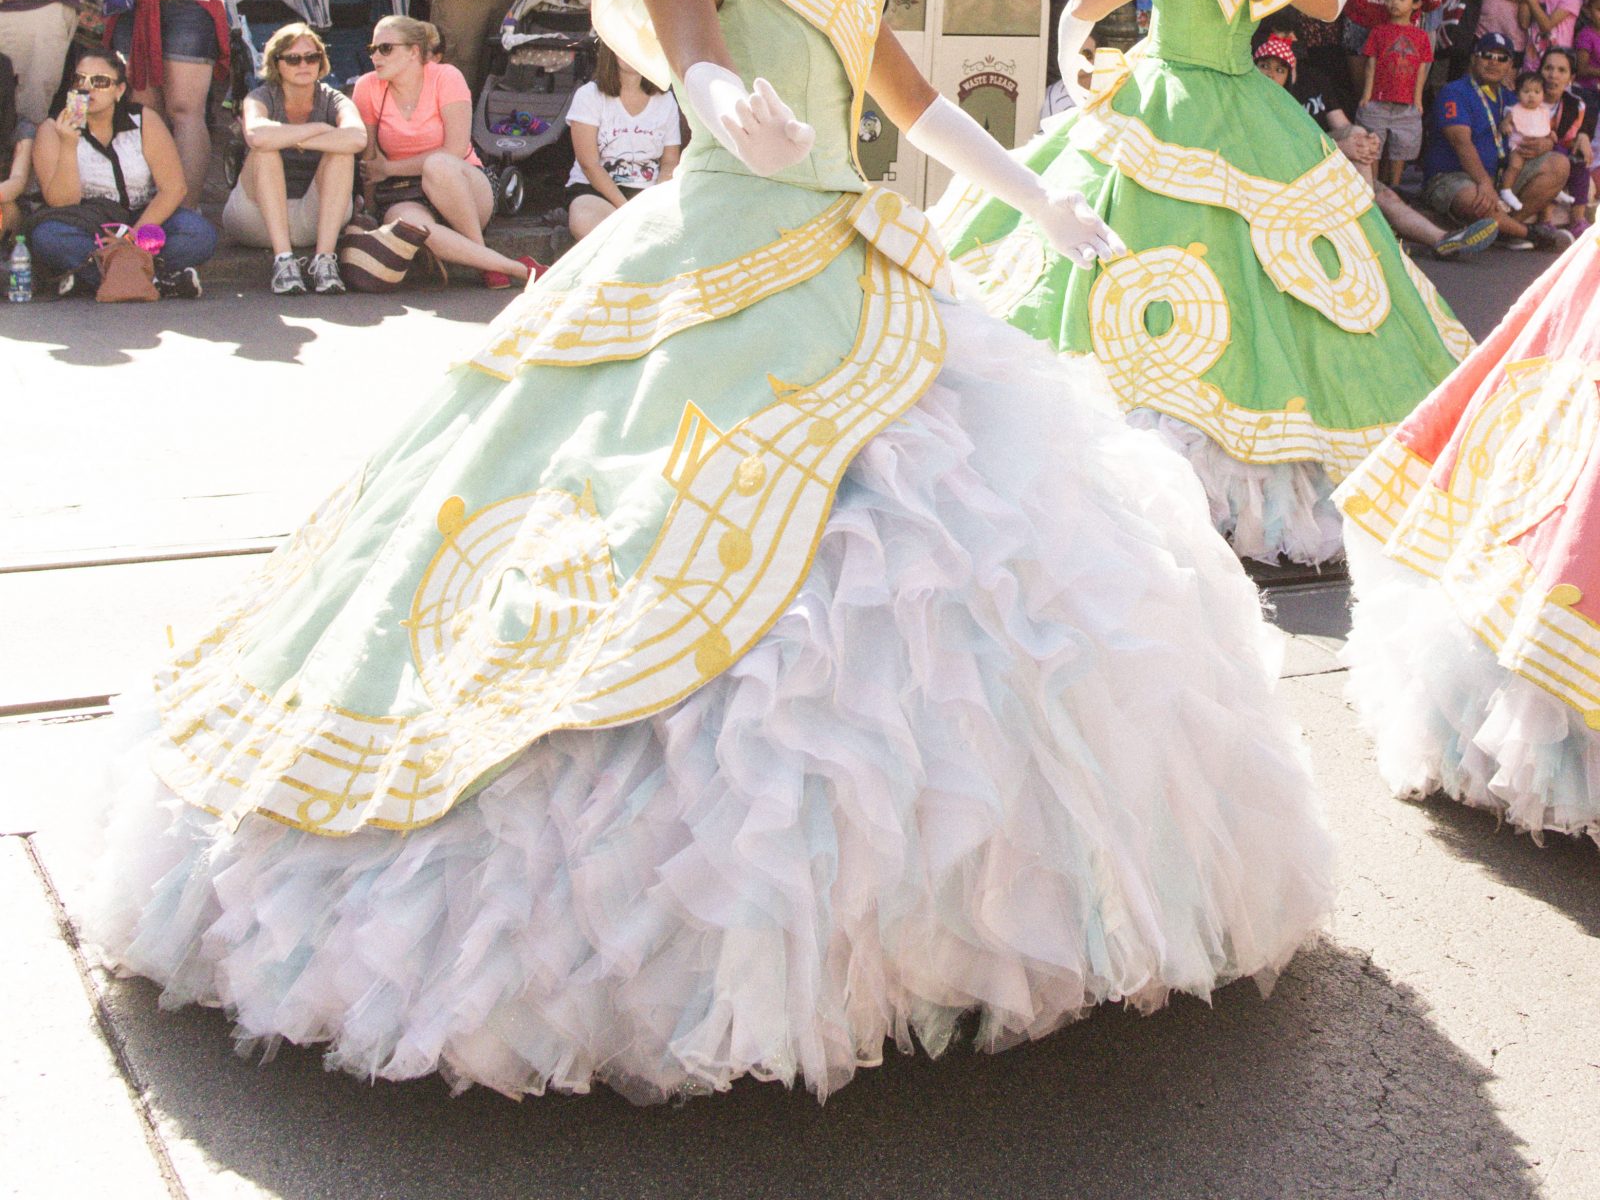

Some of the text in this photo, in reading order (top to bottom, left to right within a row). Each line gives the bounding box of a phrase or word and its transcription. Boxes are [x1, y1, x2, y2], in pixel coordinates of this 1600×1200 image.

[962, 75, 1016, 92] WASTE PLEASE
[1444, 101, 1457, 119] 3
